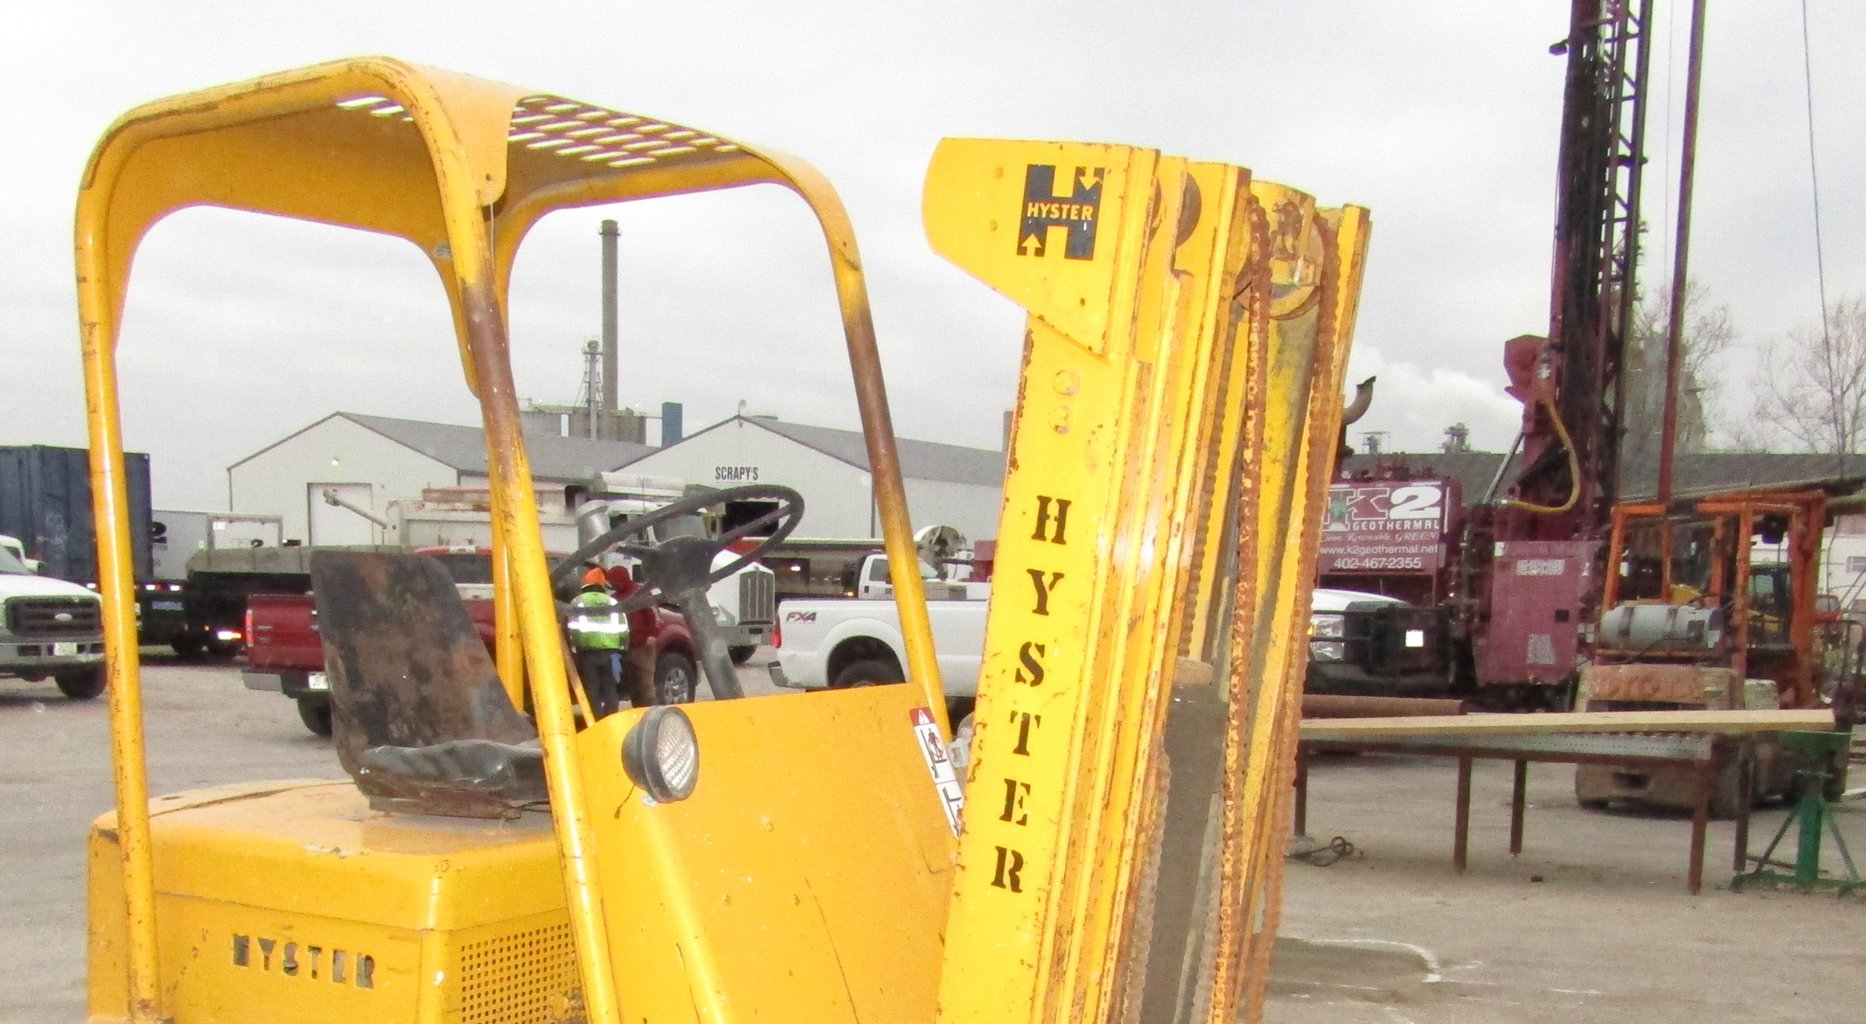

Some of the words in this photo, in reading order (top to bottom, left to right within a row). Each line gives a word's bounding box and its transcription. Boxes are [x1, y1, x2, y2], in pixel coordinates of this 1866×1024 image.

[1026, 202, 1094, 221] HYSTER
[715, 466, 759, 481] SCRAPY'S
[1321, 486, 1442, 530] K2
[1352, 520, 1440, 531] GEOTHERMAL
[1319, 543, 1439, 557] www.k2geothermal.net
[1333, 557, 1422, 569] 402-467-2355
[786, 611, 818, 623] FX4
[990, 495, 1073, 893] HYSTER
[232, 933, 376, 990] HYSTER
